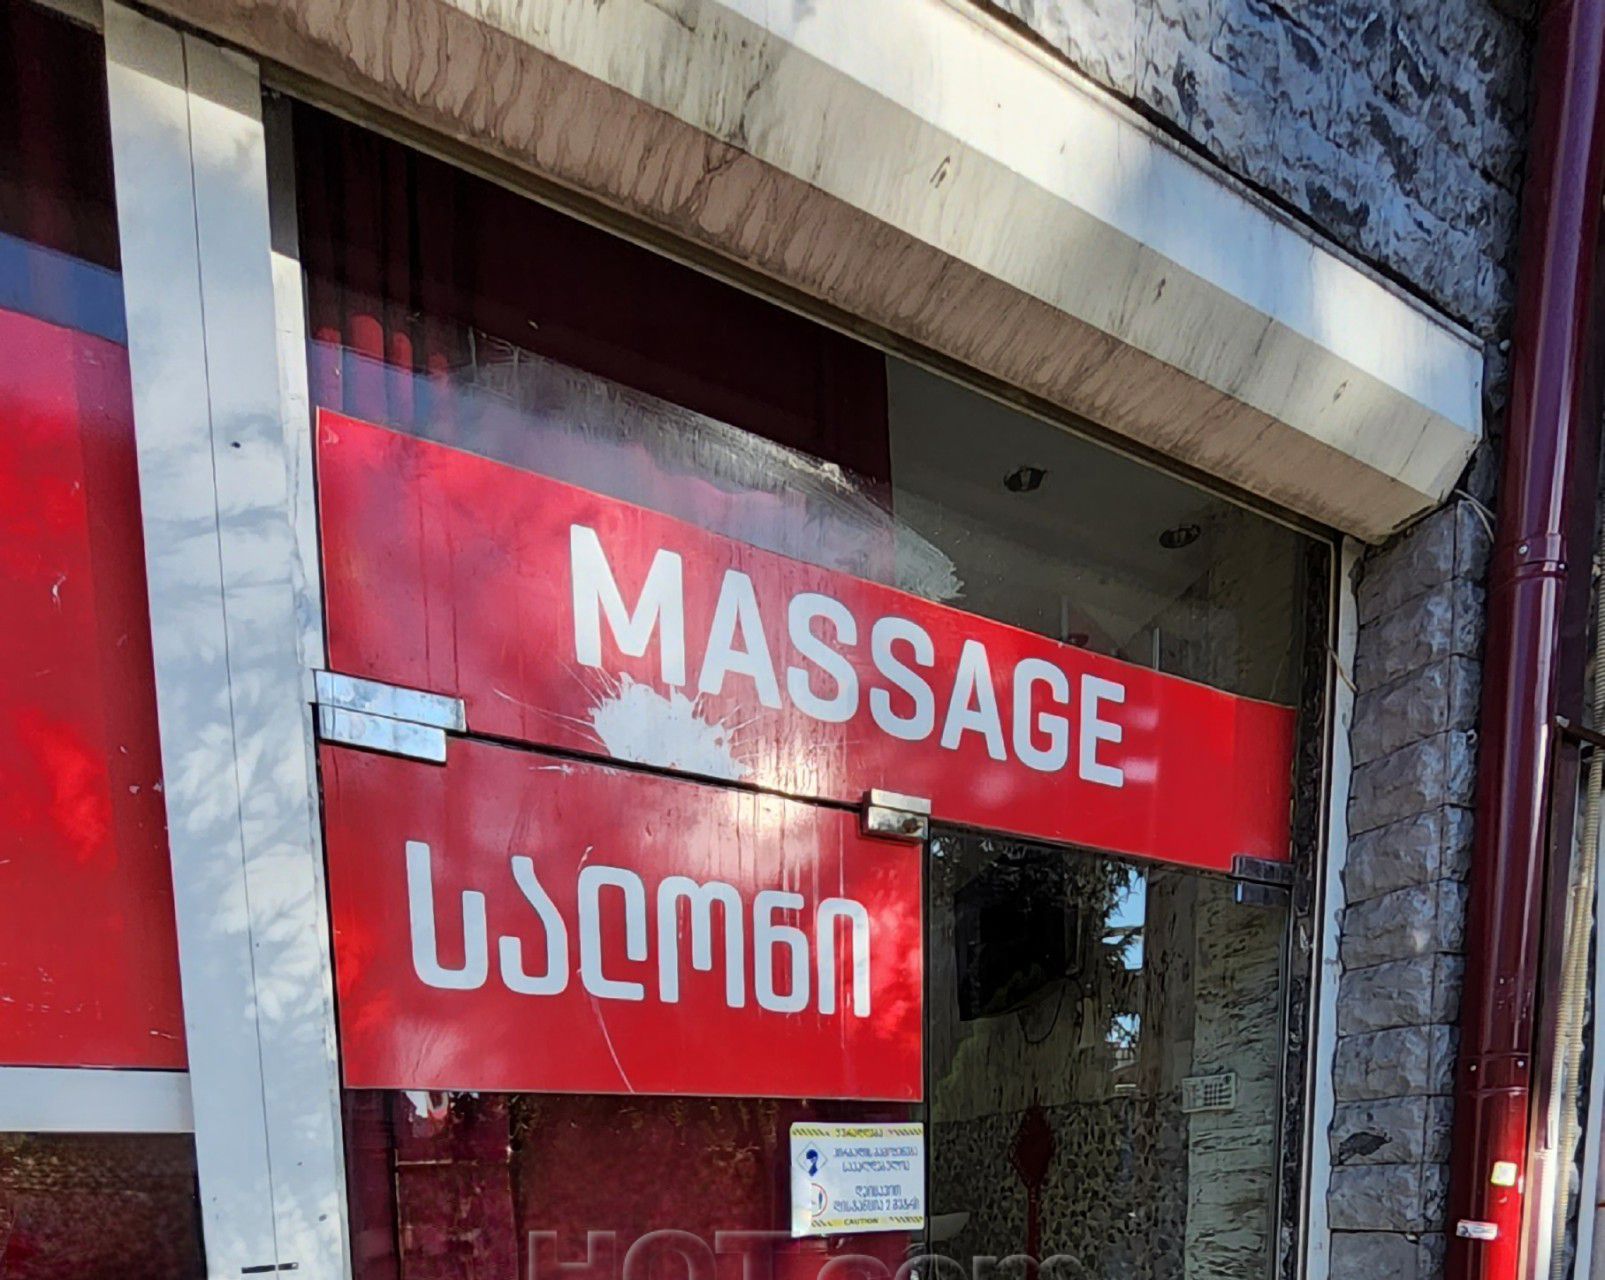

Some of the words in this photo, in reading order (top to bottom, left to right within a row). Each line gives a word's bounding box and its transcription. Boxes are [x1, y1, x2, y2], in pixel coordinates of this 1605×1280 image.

[569, 525, 1126, 788] MASSAGE
[405, 840, 871, 1018] სალონი
[843, 1218, 880, 1226] CAUTION
